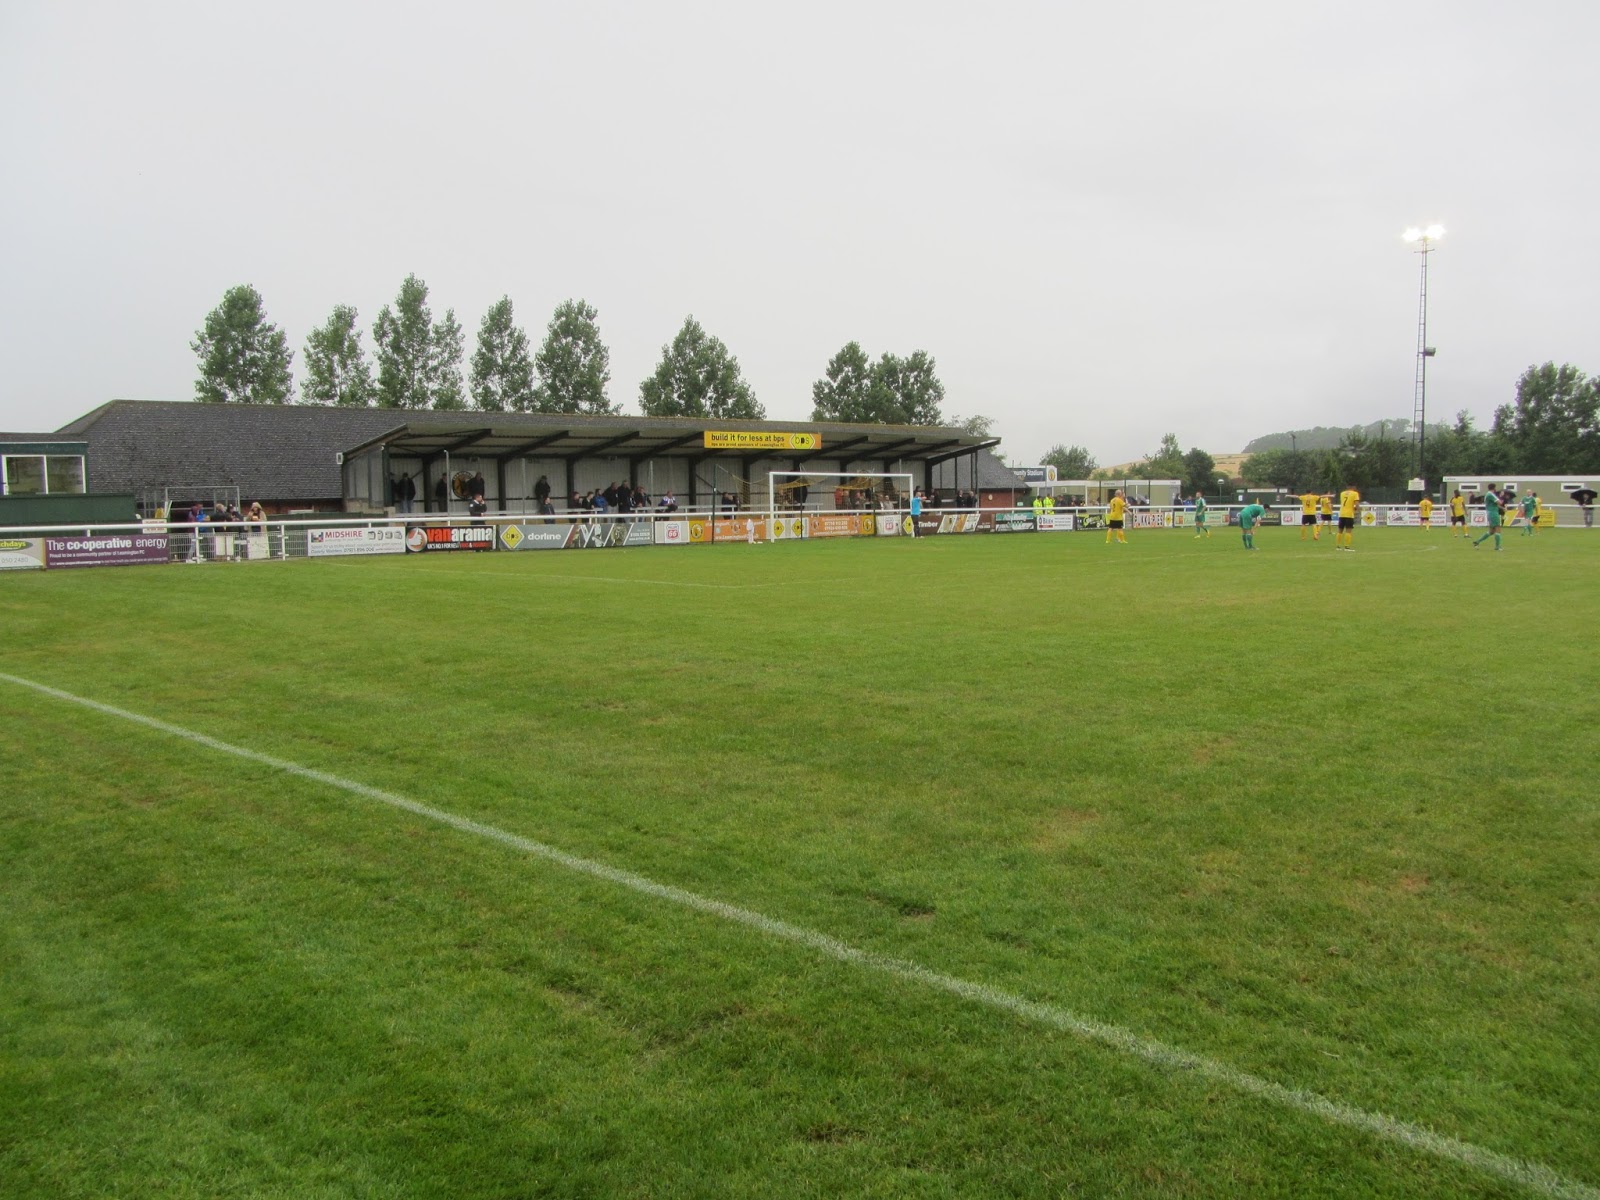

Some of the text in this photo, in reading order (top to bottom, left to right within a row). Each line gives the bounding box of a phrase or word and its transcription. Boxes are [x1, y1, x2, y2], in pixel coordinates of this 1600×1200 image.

[711, 433, 728, 441] build
[730, 433, 735, 441] it
[773, 435, 785, 443] bps
[1343, 497, 1348, 507] 7
[324, 530, 363, 539] MIDSHIRE
[427, 528, 493, 542] vanarama
[528, 532, 562, 541] dorline
[668, 530, 678, 538] 66
[47, 538, 168, 551] The co-operative energy
